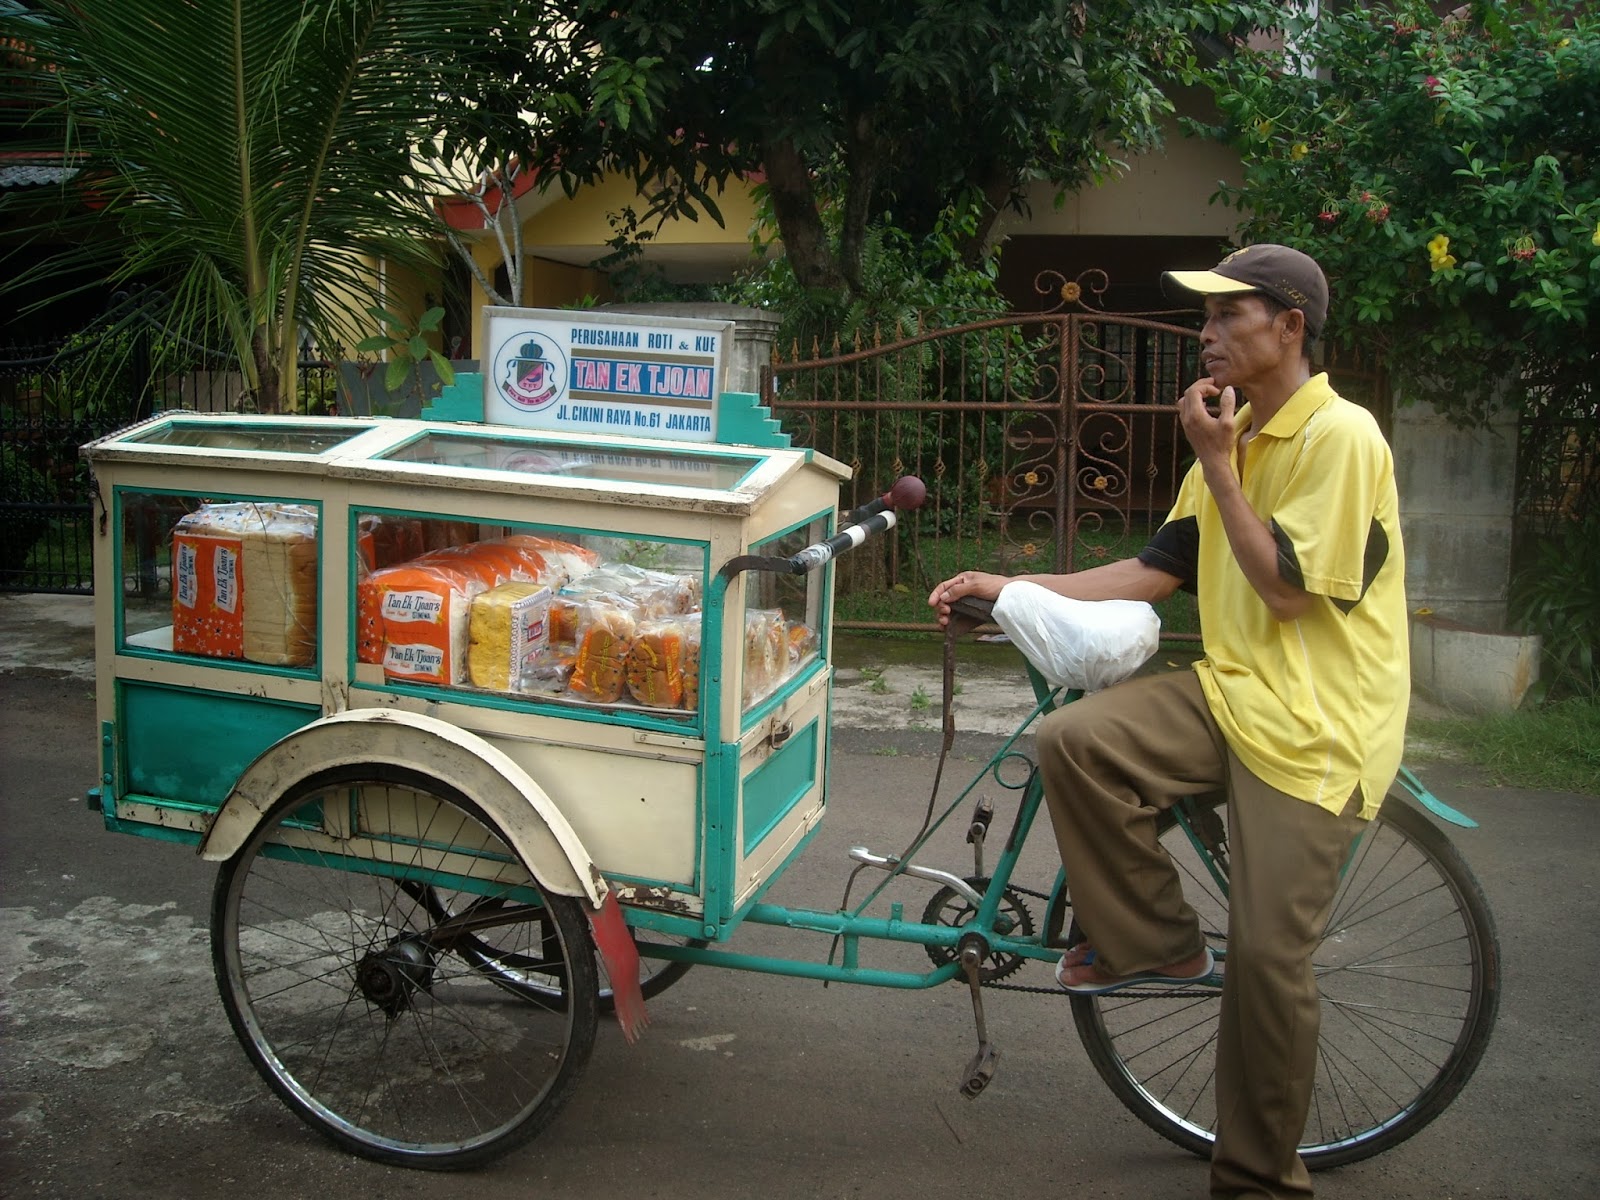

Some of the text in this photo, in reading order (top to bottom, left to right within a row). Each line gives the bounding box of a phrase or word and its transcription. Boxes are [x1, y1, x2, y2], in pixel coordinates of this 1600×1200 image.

[571, 328, 715, 353] PERUSAHAAN ROTI & KUE
[575, 360, 711, 398] TAN EK TJOAN
[572, 405, 604, 423] CIKINI
[607, 409, 631, 426] RAYA
[634, 411, 660, 428] No.61
[666, 413, 711, 432] JAKARTA
[217, 578, 228, 590] Ek
[217, 590, 227, 604] Tan
[388, 594, 401, 609] Tan
[402, 595, 412, 610] Ek
[390, 647, 403, 660] Tan
[404, 648, 415, 662] Ek
